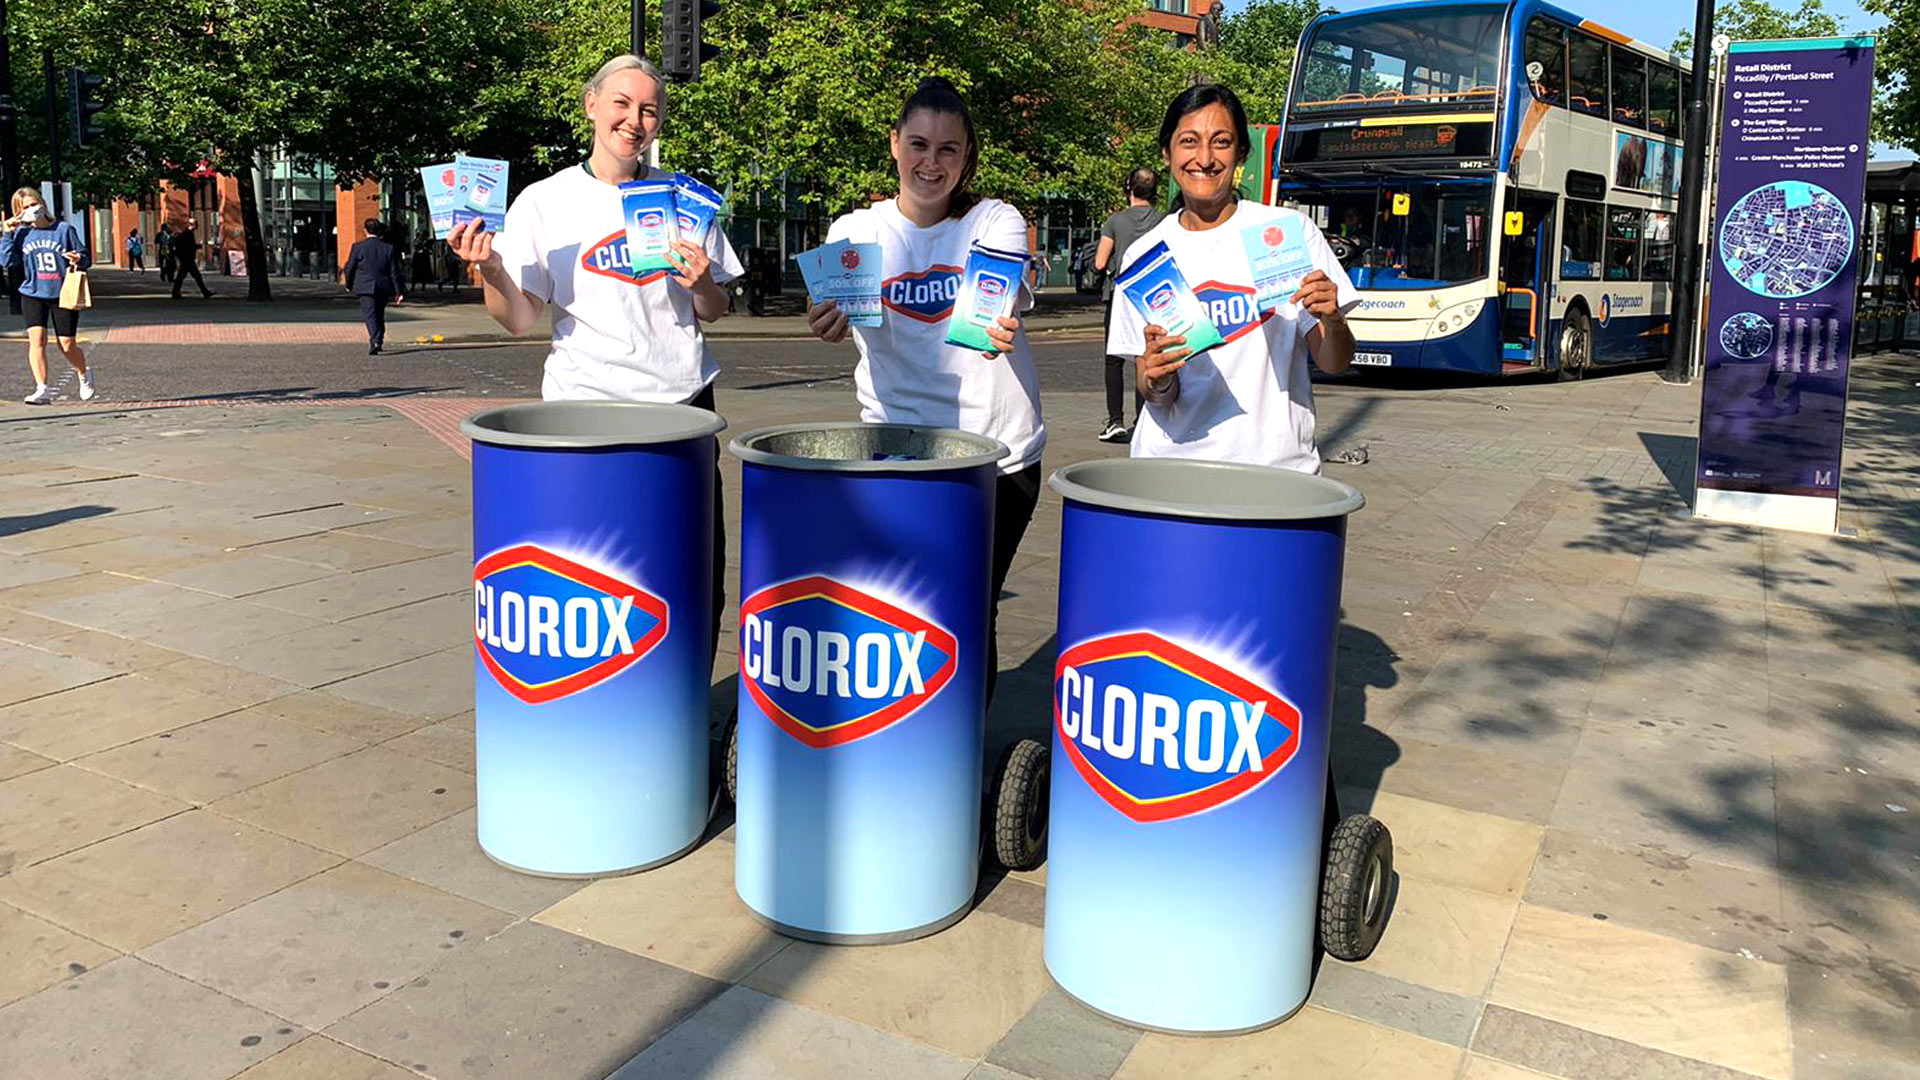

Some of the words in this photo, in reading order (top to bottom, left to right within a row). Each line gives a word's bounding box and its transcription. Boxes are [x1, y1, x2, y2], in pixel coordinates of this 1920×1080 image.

[1760, 63, 1791, 71] District
[37, 252, 57, 271] 19
[890, 275, 962, 304] CLORO
[1612, 293, 1643, 312] Stagecoach
[1815, 470, 1831, 485] M
[475, 580, 634, 658] CLOROX
[745, 613, 927, 699] CLOROX
[1062, 665, 1267, 774] CLOROX
